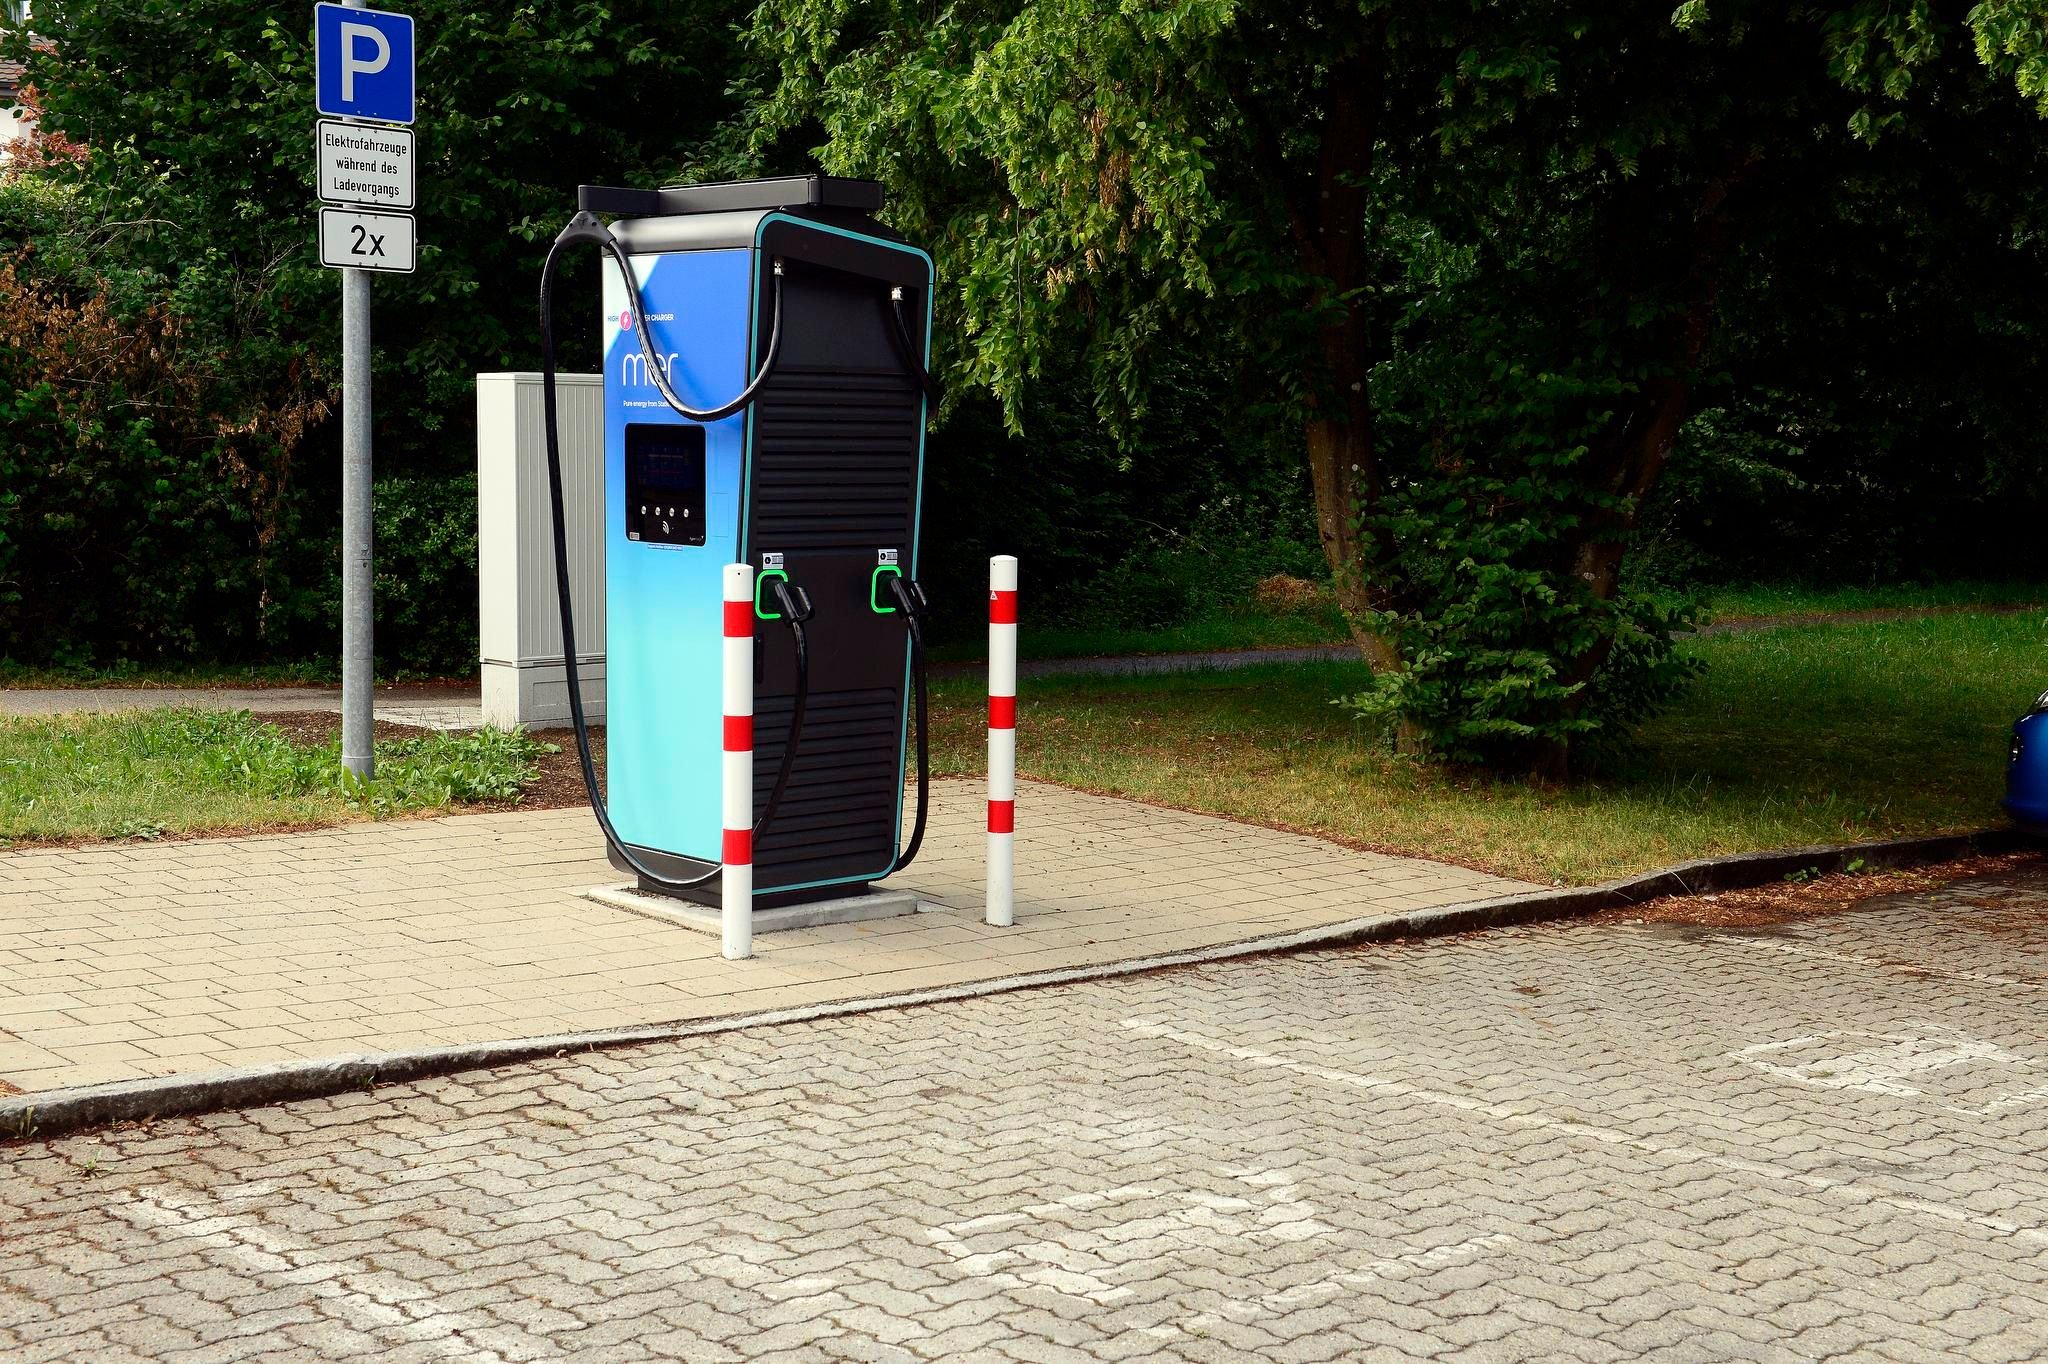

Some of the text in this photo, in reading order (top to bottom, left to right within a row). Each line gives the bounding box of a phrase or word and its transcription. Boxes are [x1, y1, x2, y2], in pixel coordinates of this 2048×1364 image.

[341, 21, 391, 102] P
[325, 133, 407, 157] Elektrofahrzeuge
[336, 157, 398, 175] während des
[334, 177, 400, 198] Ladevorgangs
[350, 224, 385, 257] 2x
[651, 313, 675, 322] CHARGER
[633, 401, 647, 409] energy
